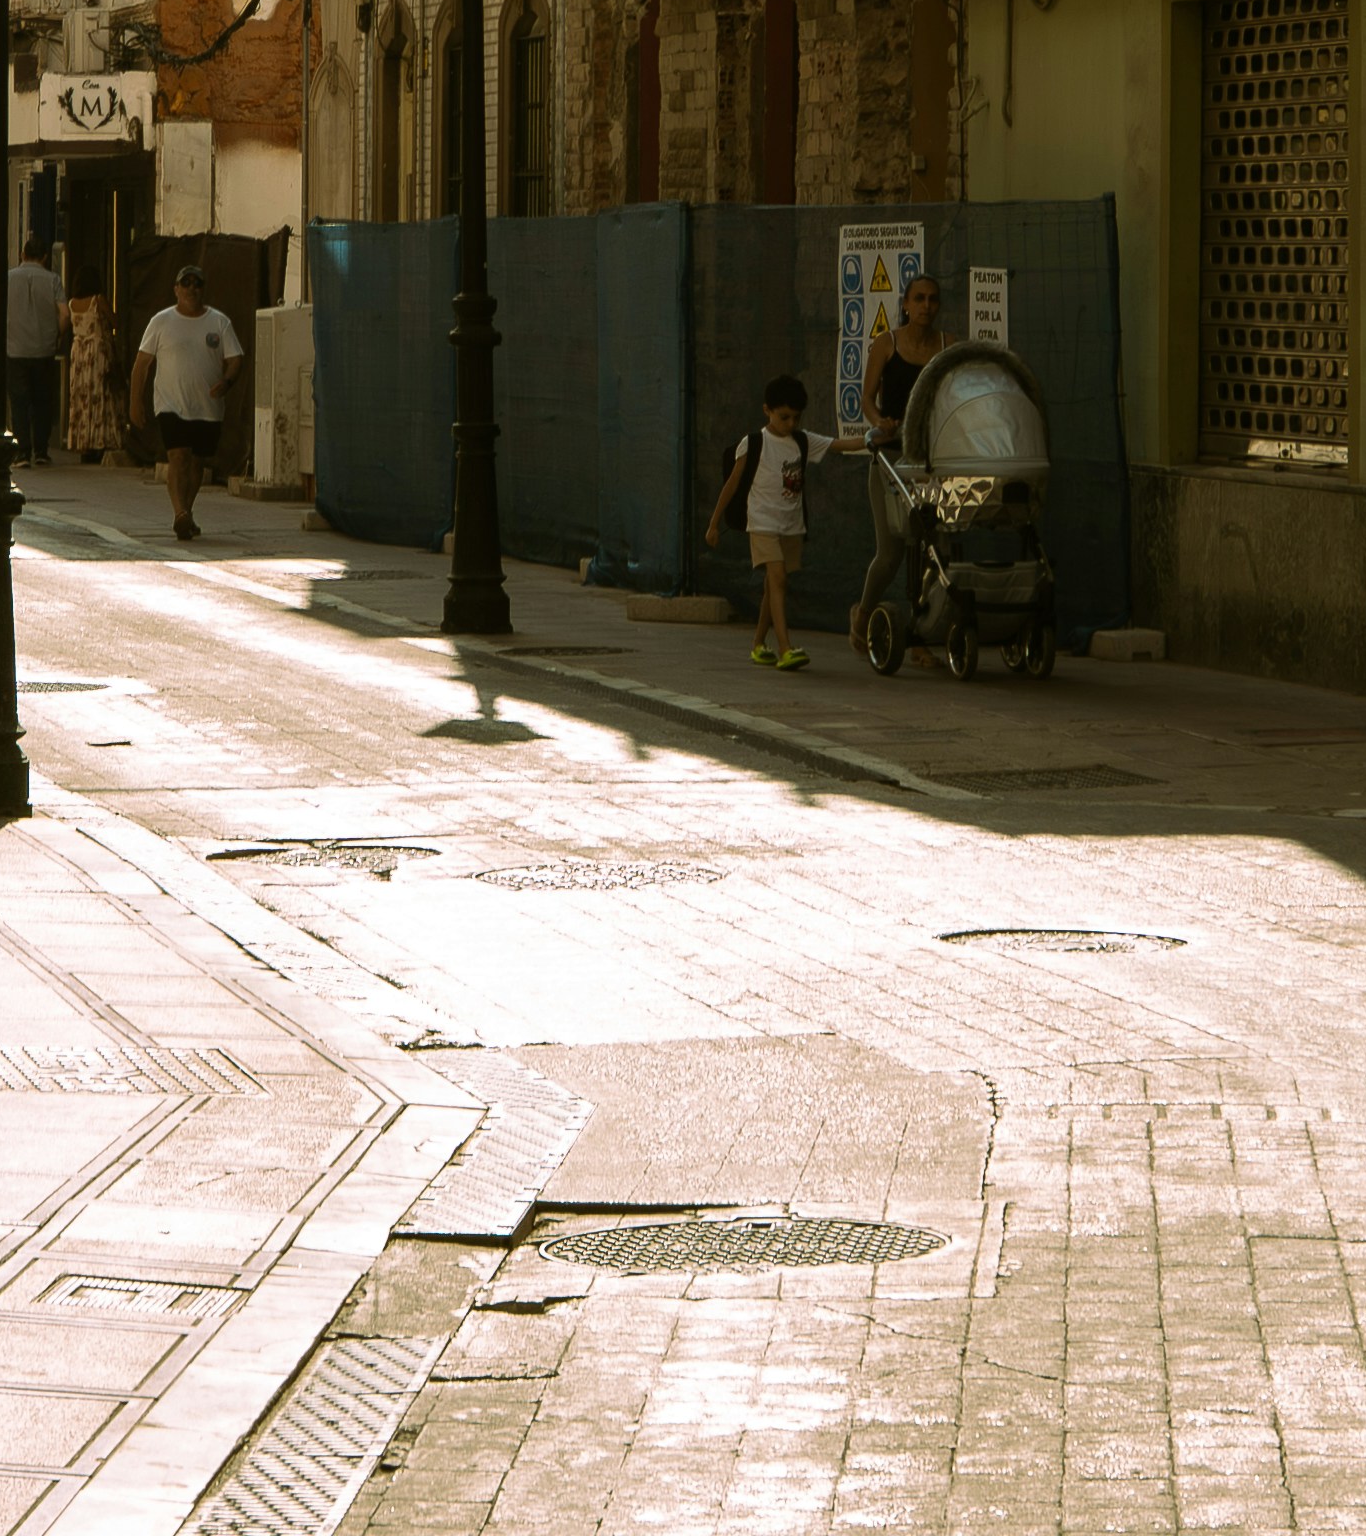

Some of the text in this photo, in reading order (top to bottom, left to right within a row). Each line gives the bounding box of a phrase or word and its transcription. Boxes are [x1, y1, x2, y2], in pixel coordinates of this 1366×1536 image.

[80, 95, 104, 117] M
[973, 272, 1003, 284] PEATON
[975, 291, 1000, 303] CRUCE
[975, 310, 1001, 322] POR LA
[978, 329, 998, 341] OTRA
